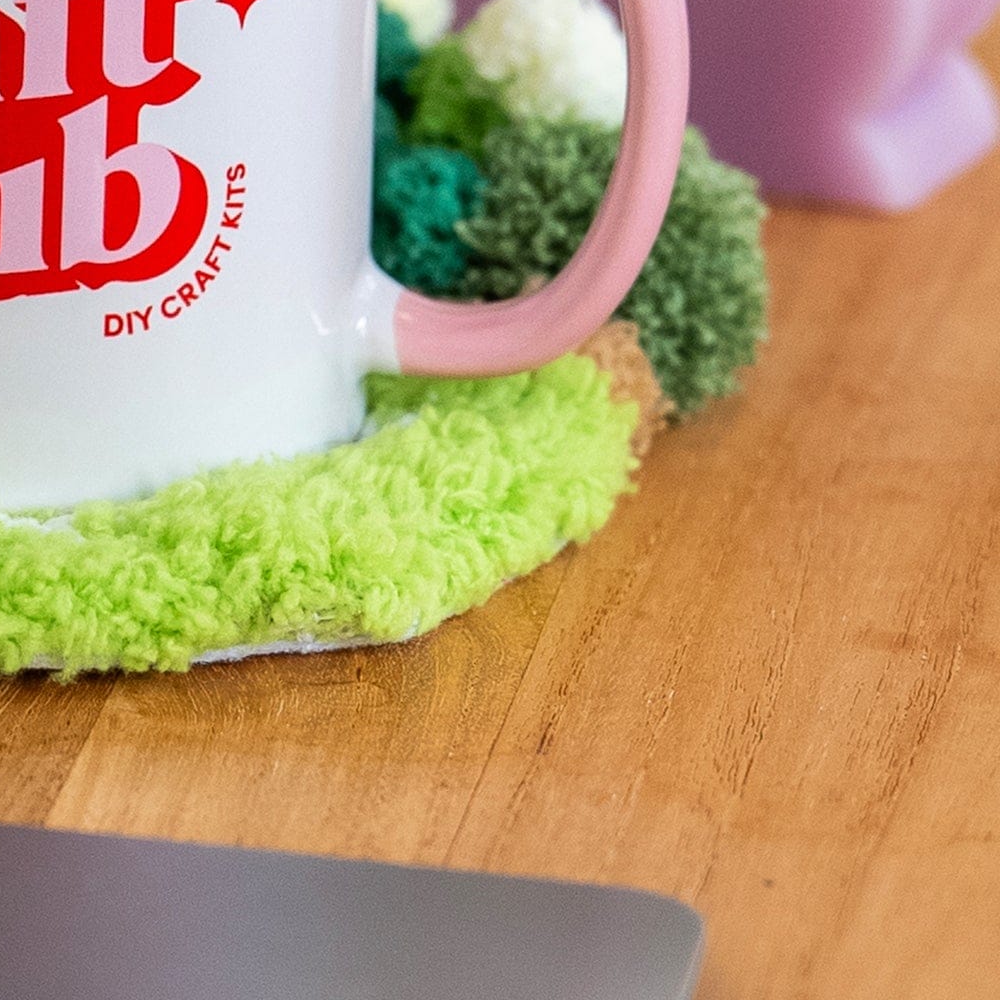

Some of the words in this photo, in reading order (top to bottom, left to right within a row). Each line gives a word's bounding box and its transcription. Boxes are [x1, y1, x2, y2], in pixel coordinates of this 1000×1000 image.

[104, 305, 153, 337] DIY
[160, 234, 232, 319] CRAFT
[220, 162, 246, 229] KITS
